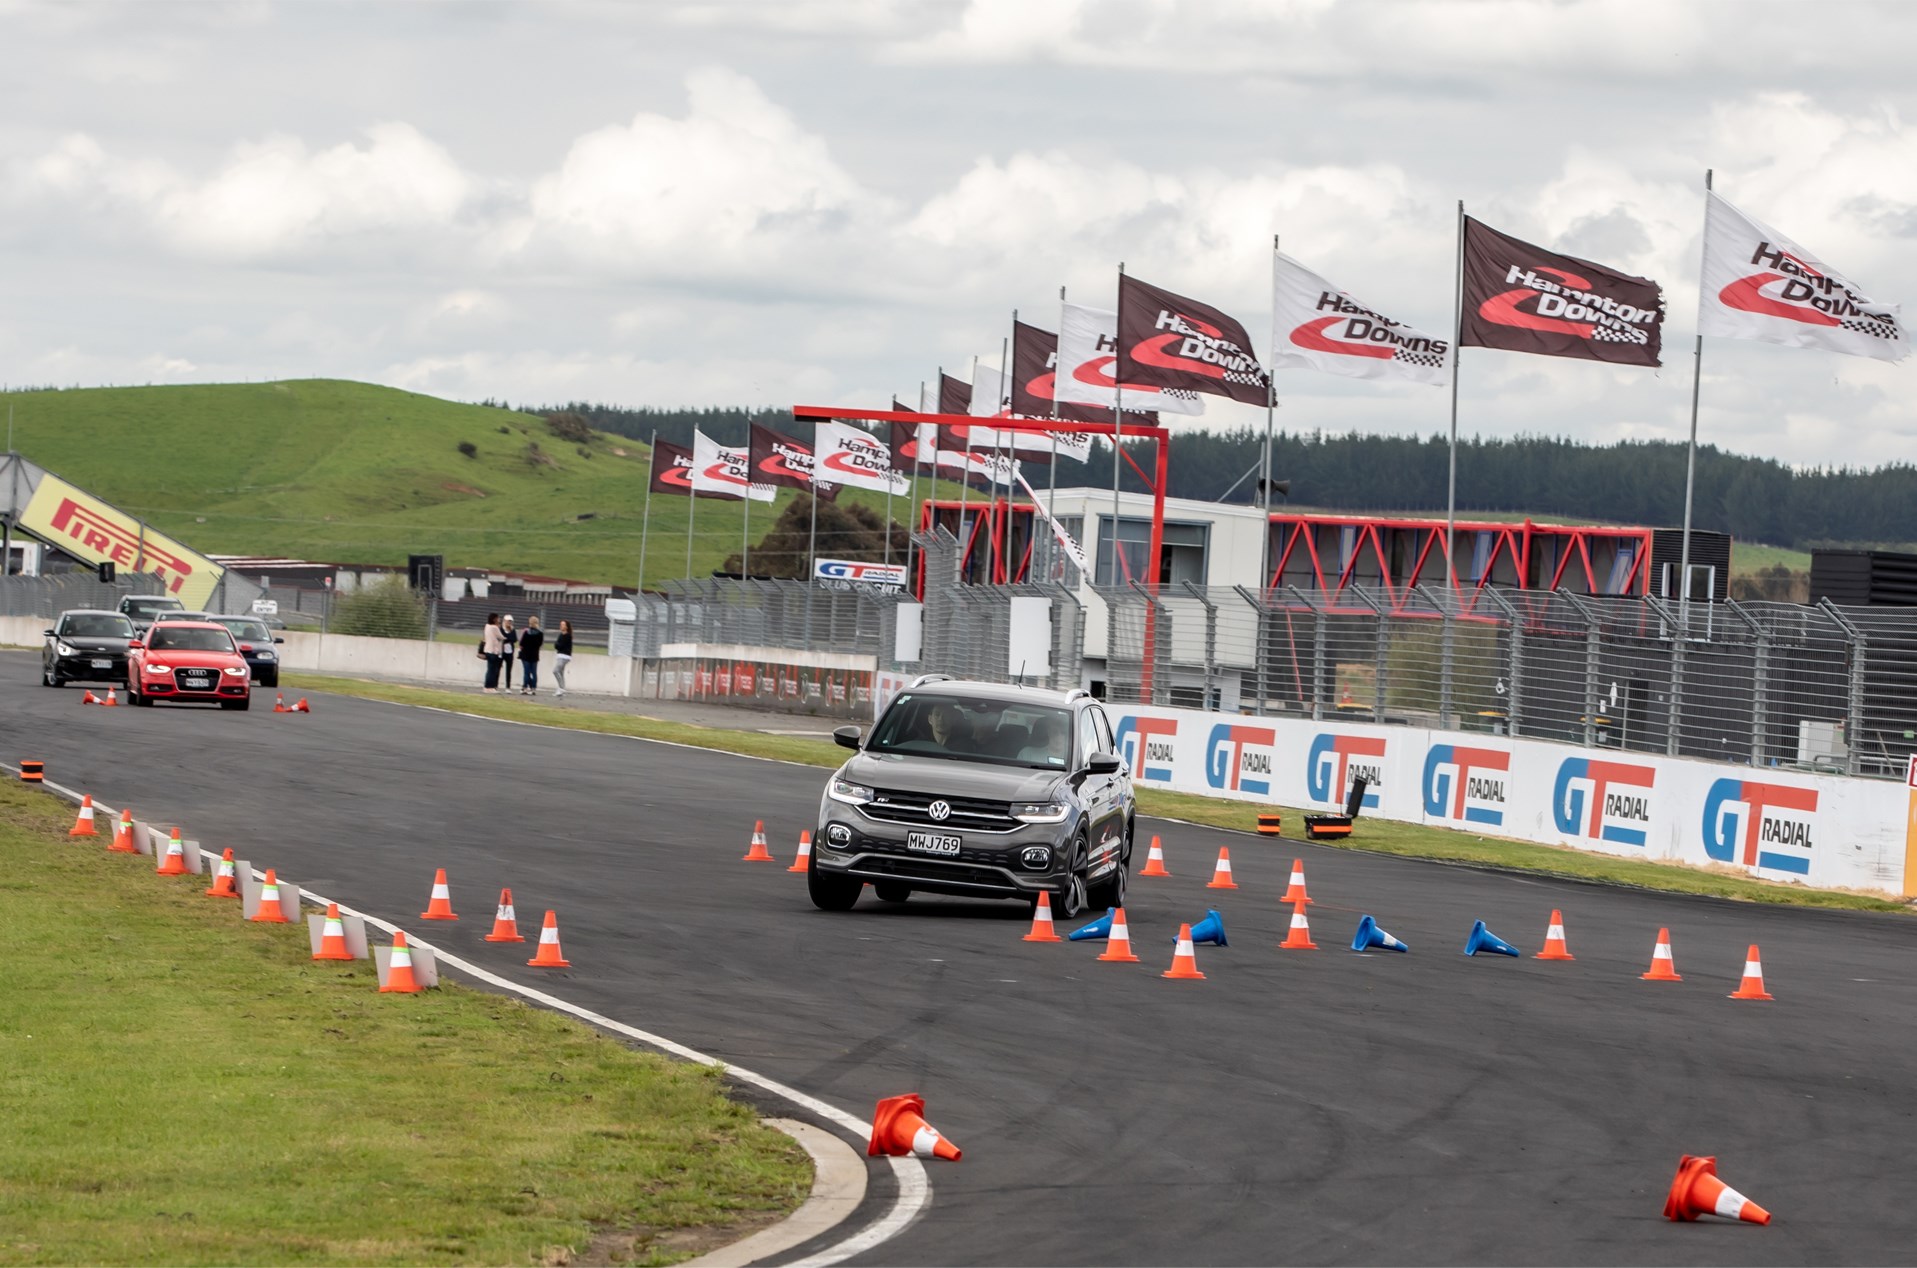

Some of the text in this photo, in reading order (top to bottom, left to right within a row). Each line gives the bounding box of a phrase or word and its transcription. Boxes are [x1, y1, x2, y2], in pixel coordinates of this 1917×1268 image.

[1343, 318, 1448, 355] Downs
[1536, 292, 1649, 345] Downs
[772, 442, 817, 466] Hamp
[838, 438, 891, 460] Hamp
[50, 497, 192, 594] PIRELLI
[819, 563, 903, 578] GT
[1115, 716, 1178, 779] GT RADIAL
[1206, 723, 1275, 790] GT RADIAL
[1307, 733, 1386, 804] GT
[1422, 744, 1510, 820] GT RADIAL
[1553, 757, 1656, 839] GT RADIAL
[909, 834, 959, 852] MWJ769
[1702, 778, 1818, 866] GT RADIAL
